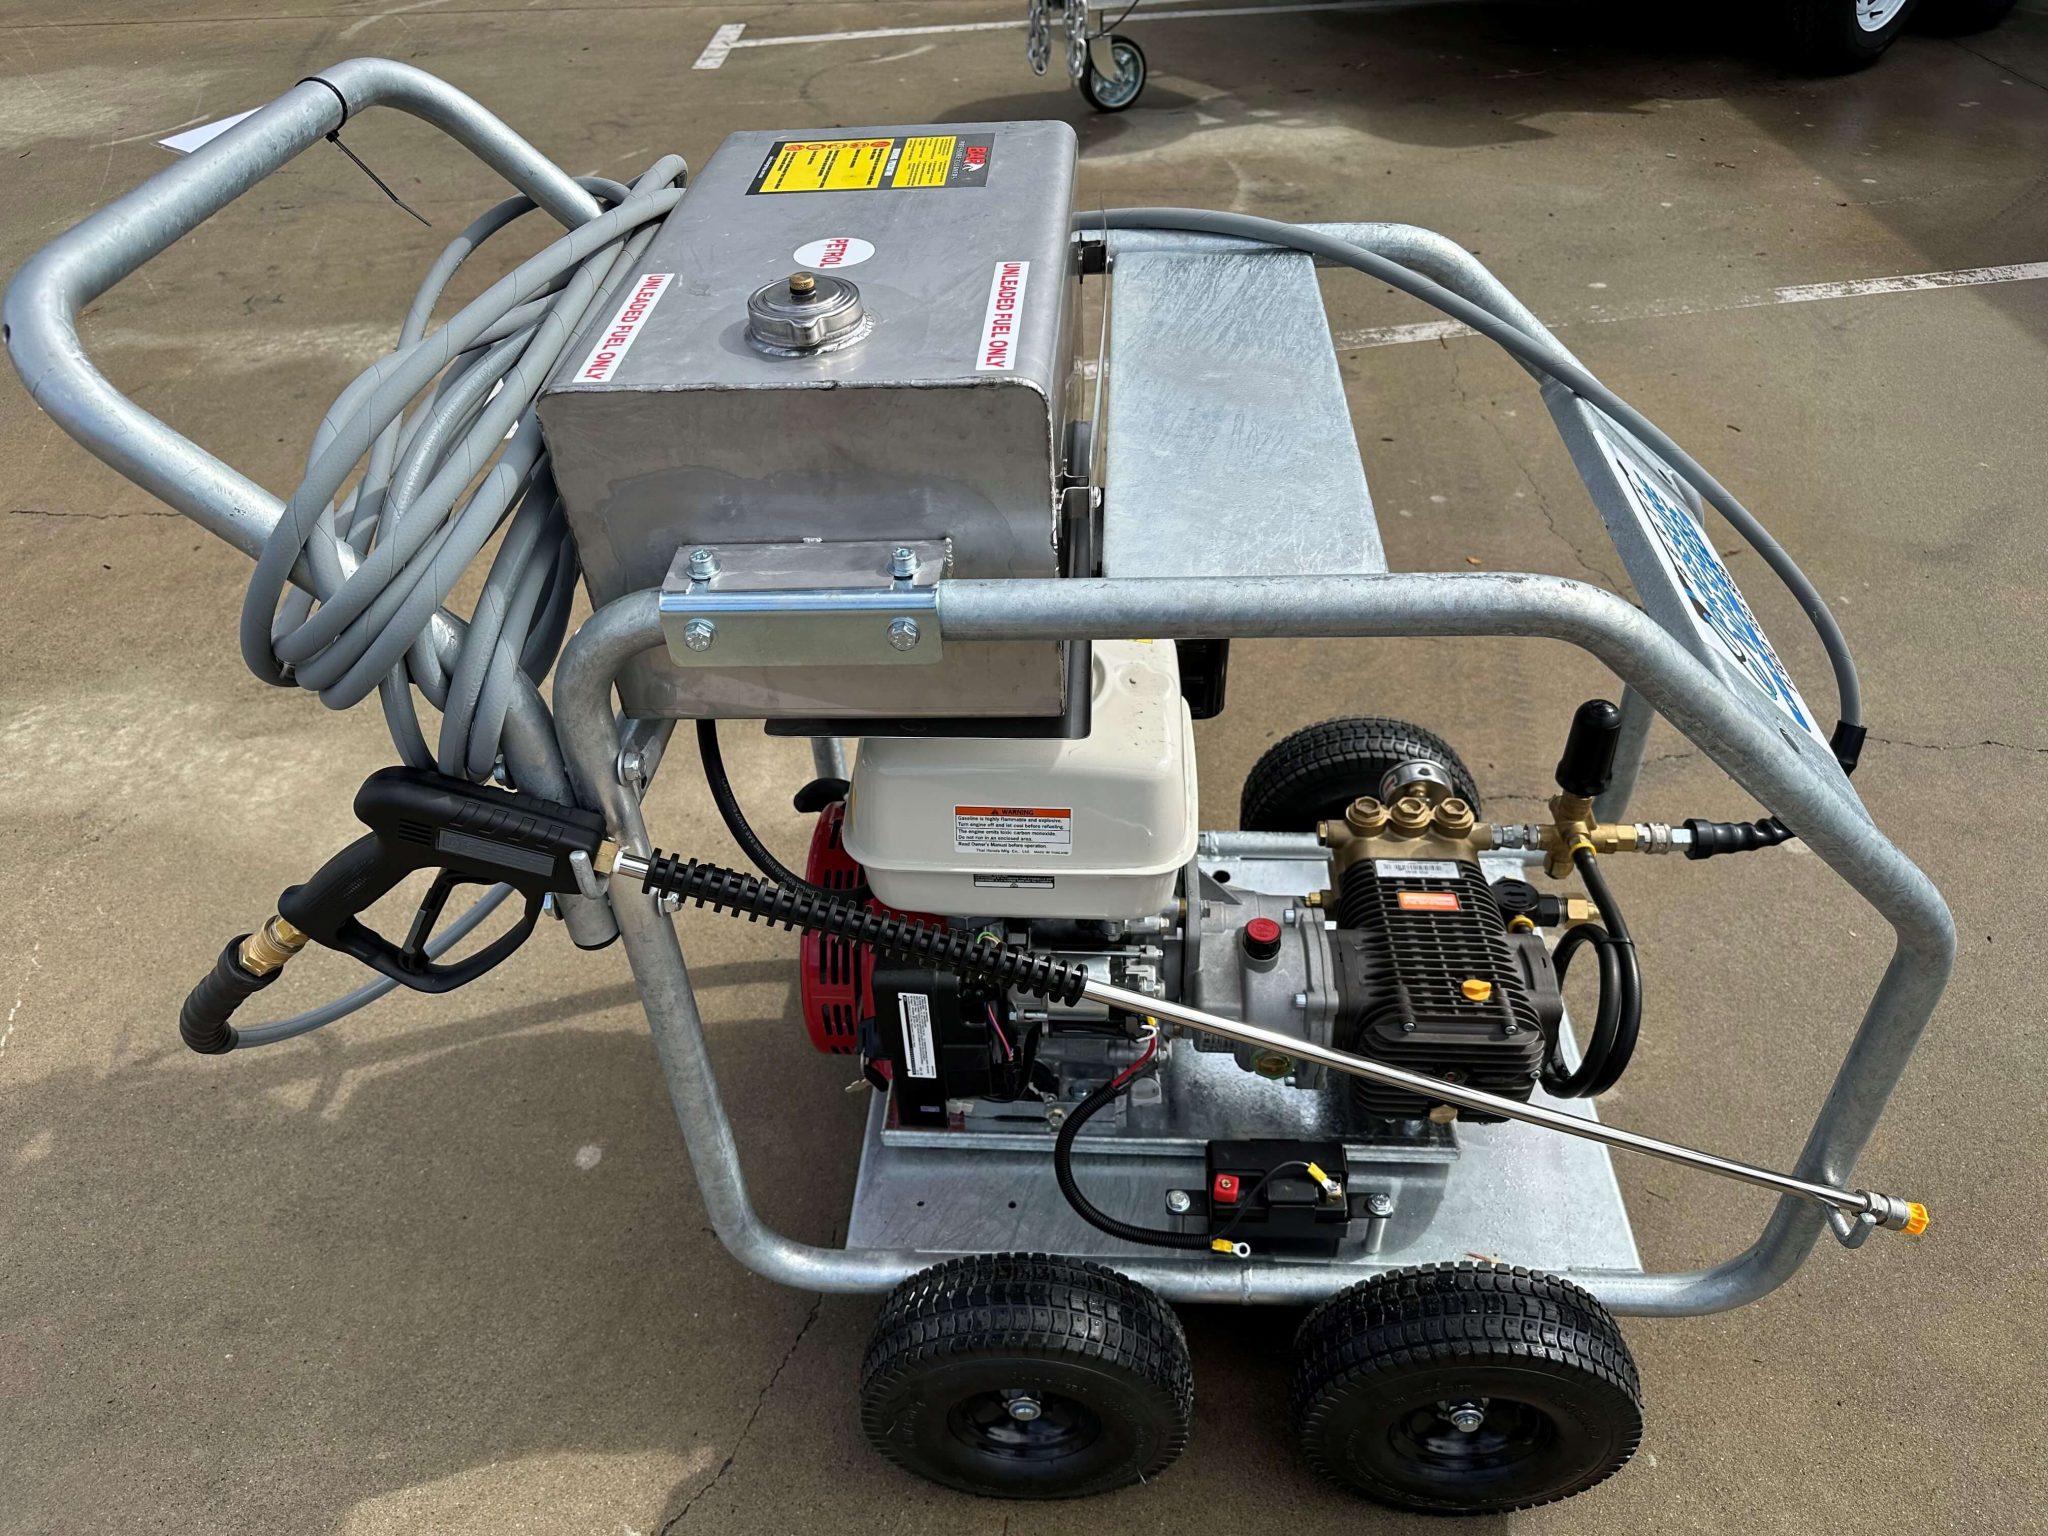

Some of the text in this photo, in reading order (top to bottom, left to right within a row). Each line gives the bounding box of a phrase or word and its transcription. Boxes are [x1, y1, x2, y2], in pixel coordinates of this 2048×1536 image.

[964, 146, 988, 166] BAR
[820, 239, 849, 267] PETROL
[584, 275, 666, 380] UNLEADED FUEL ONLY
[986, 262, 1021, 368] UNLEADED FUEL ONLY
[1631, 480, 1694, 584] PERTH
[1632, 469, 1737, 639] PRESSURE
[1658, 495, 1758, 655] WASHERS
[1760, 640, 1797, 693] 1300
[762, 854, 776, 869] FUEL
